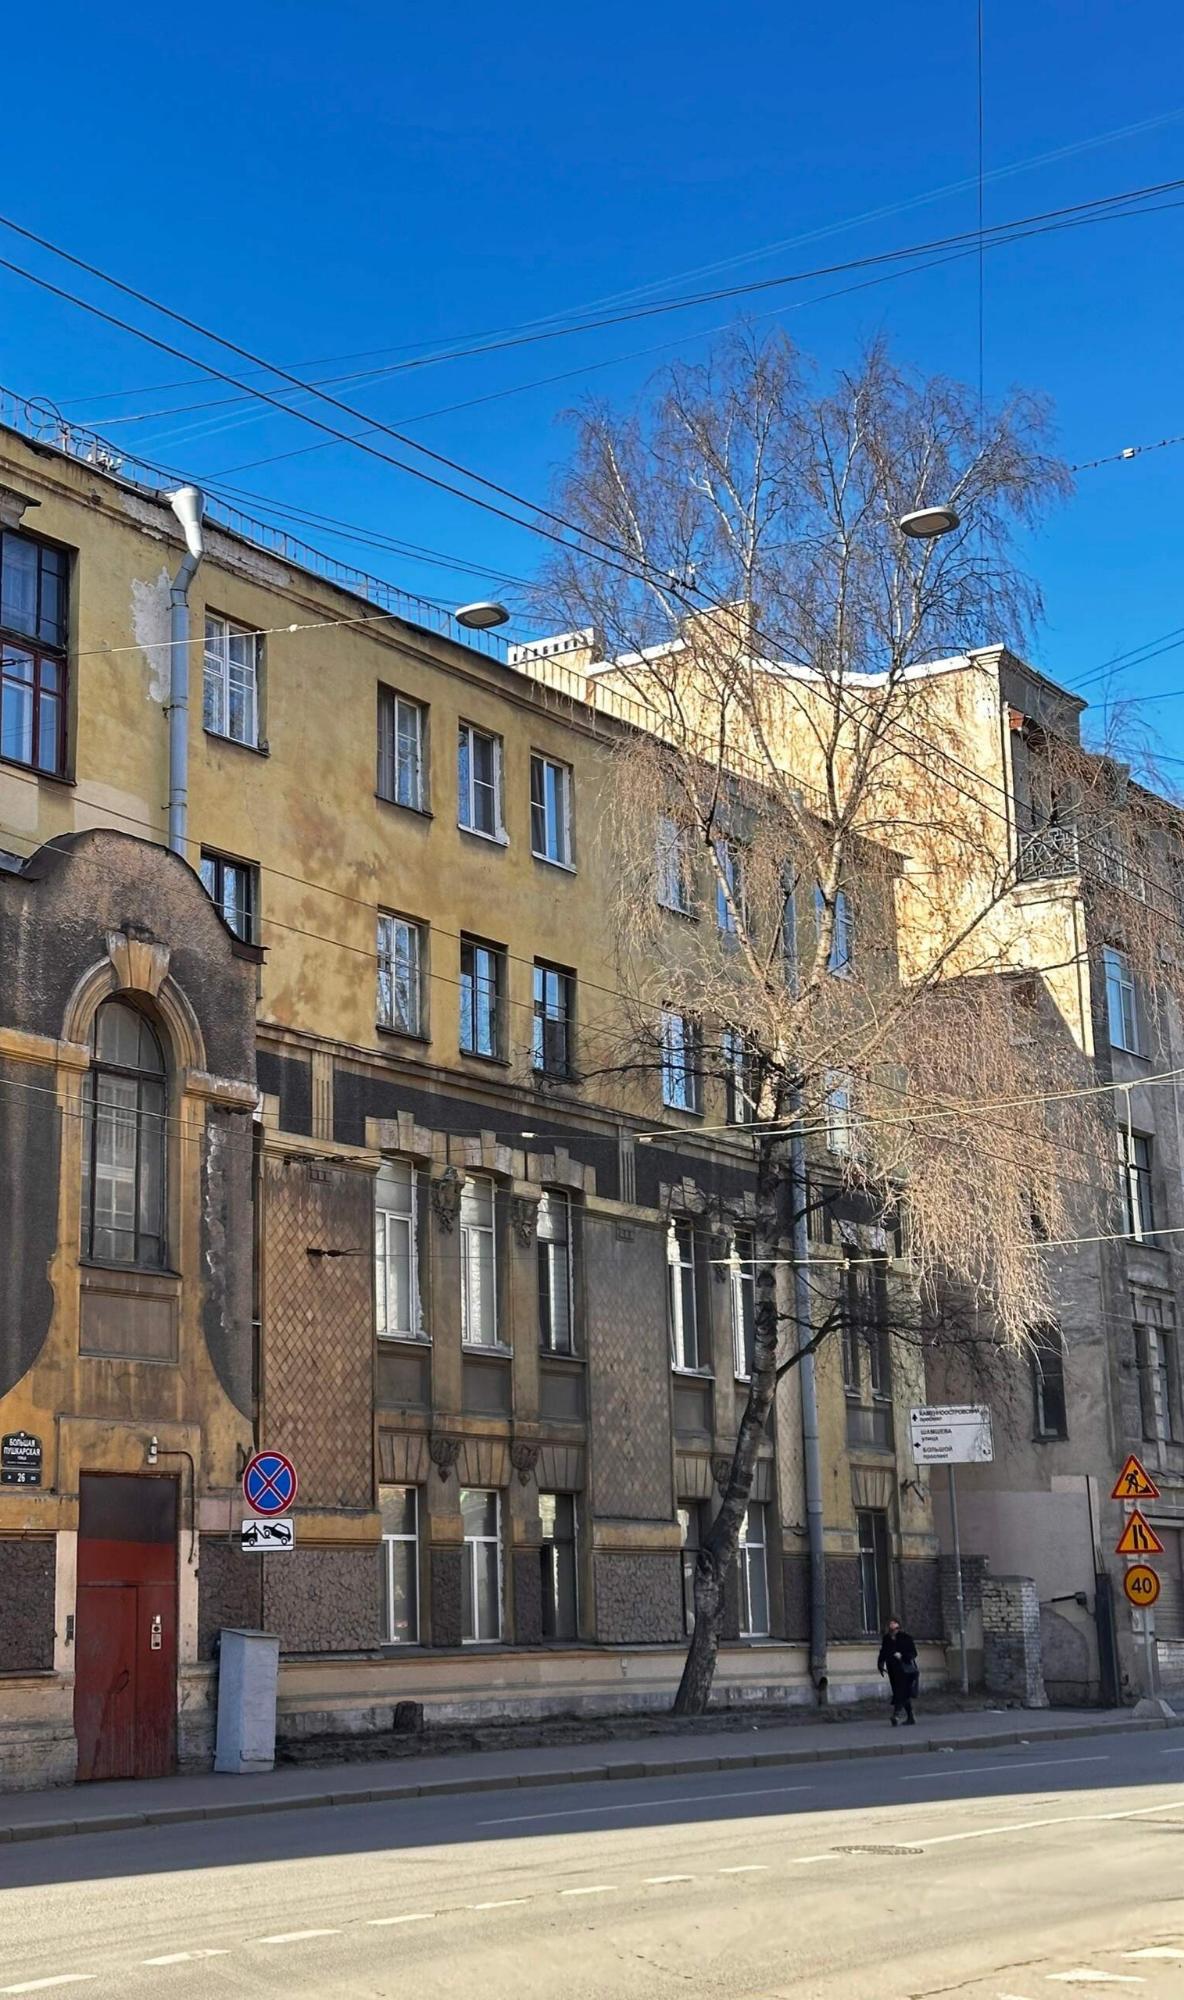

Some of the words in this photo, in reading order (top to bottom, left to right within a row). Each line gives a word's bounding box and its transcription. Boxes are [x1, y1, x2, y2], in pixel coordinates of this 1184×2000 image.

[9, 1438, 36, 1447] БОЛЬШАЯ
[3, 1446, 41, 1456] ПУШКАРСКАЯ
[17, 1472, 26, 1482] 26
[1131, 1577, 1152, 1594] 40
